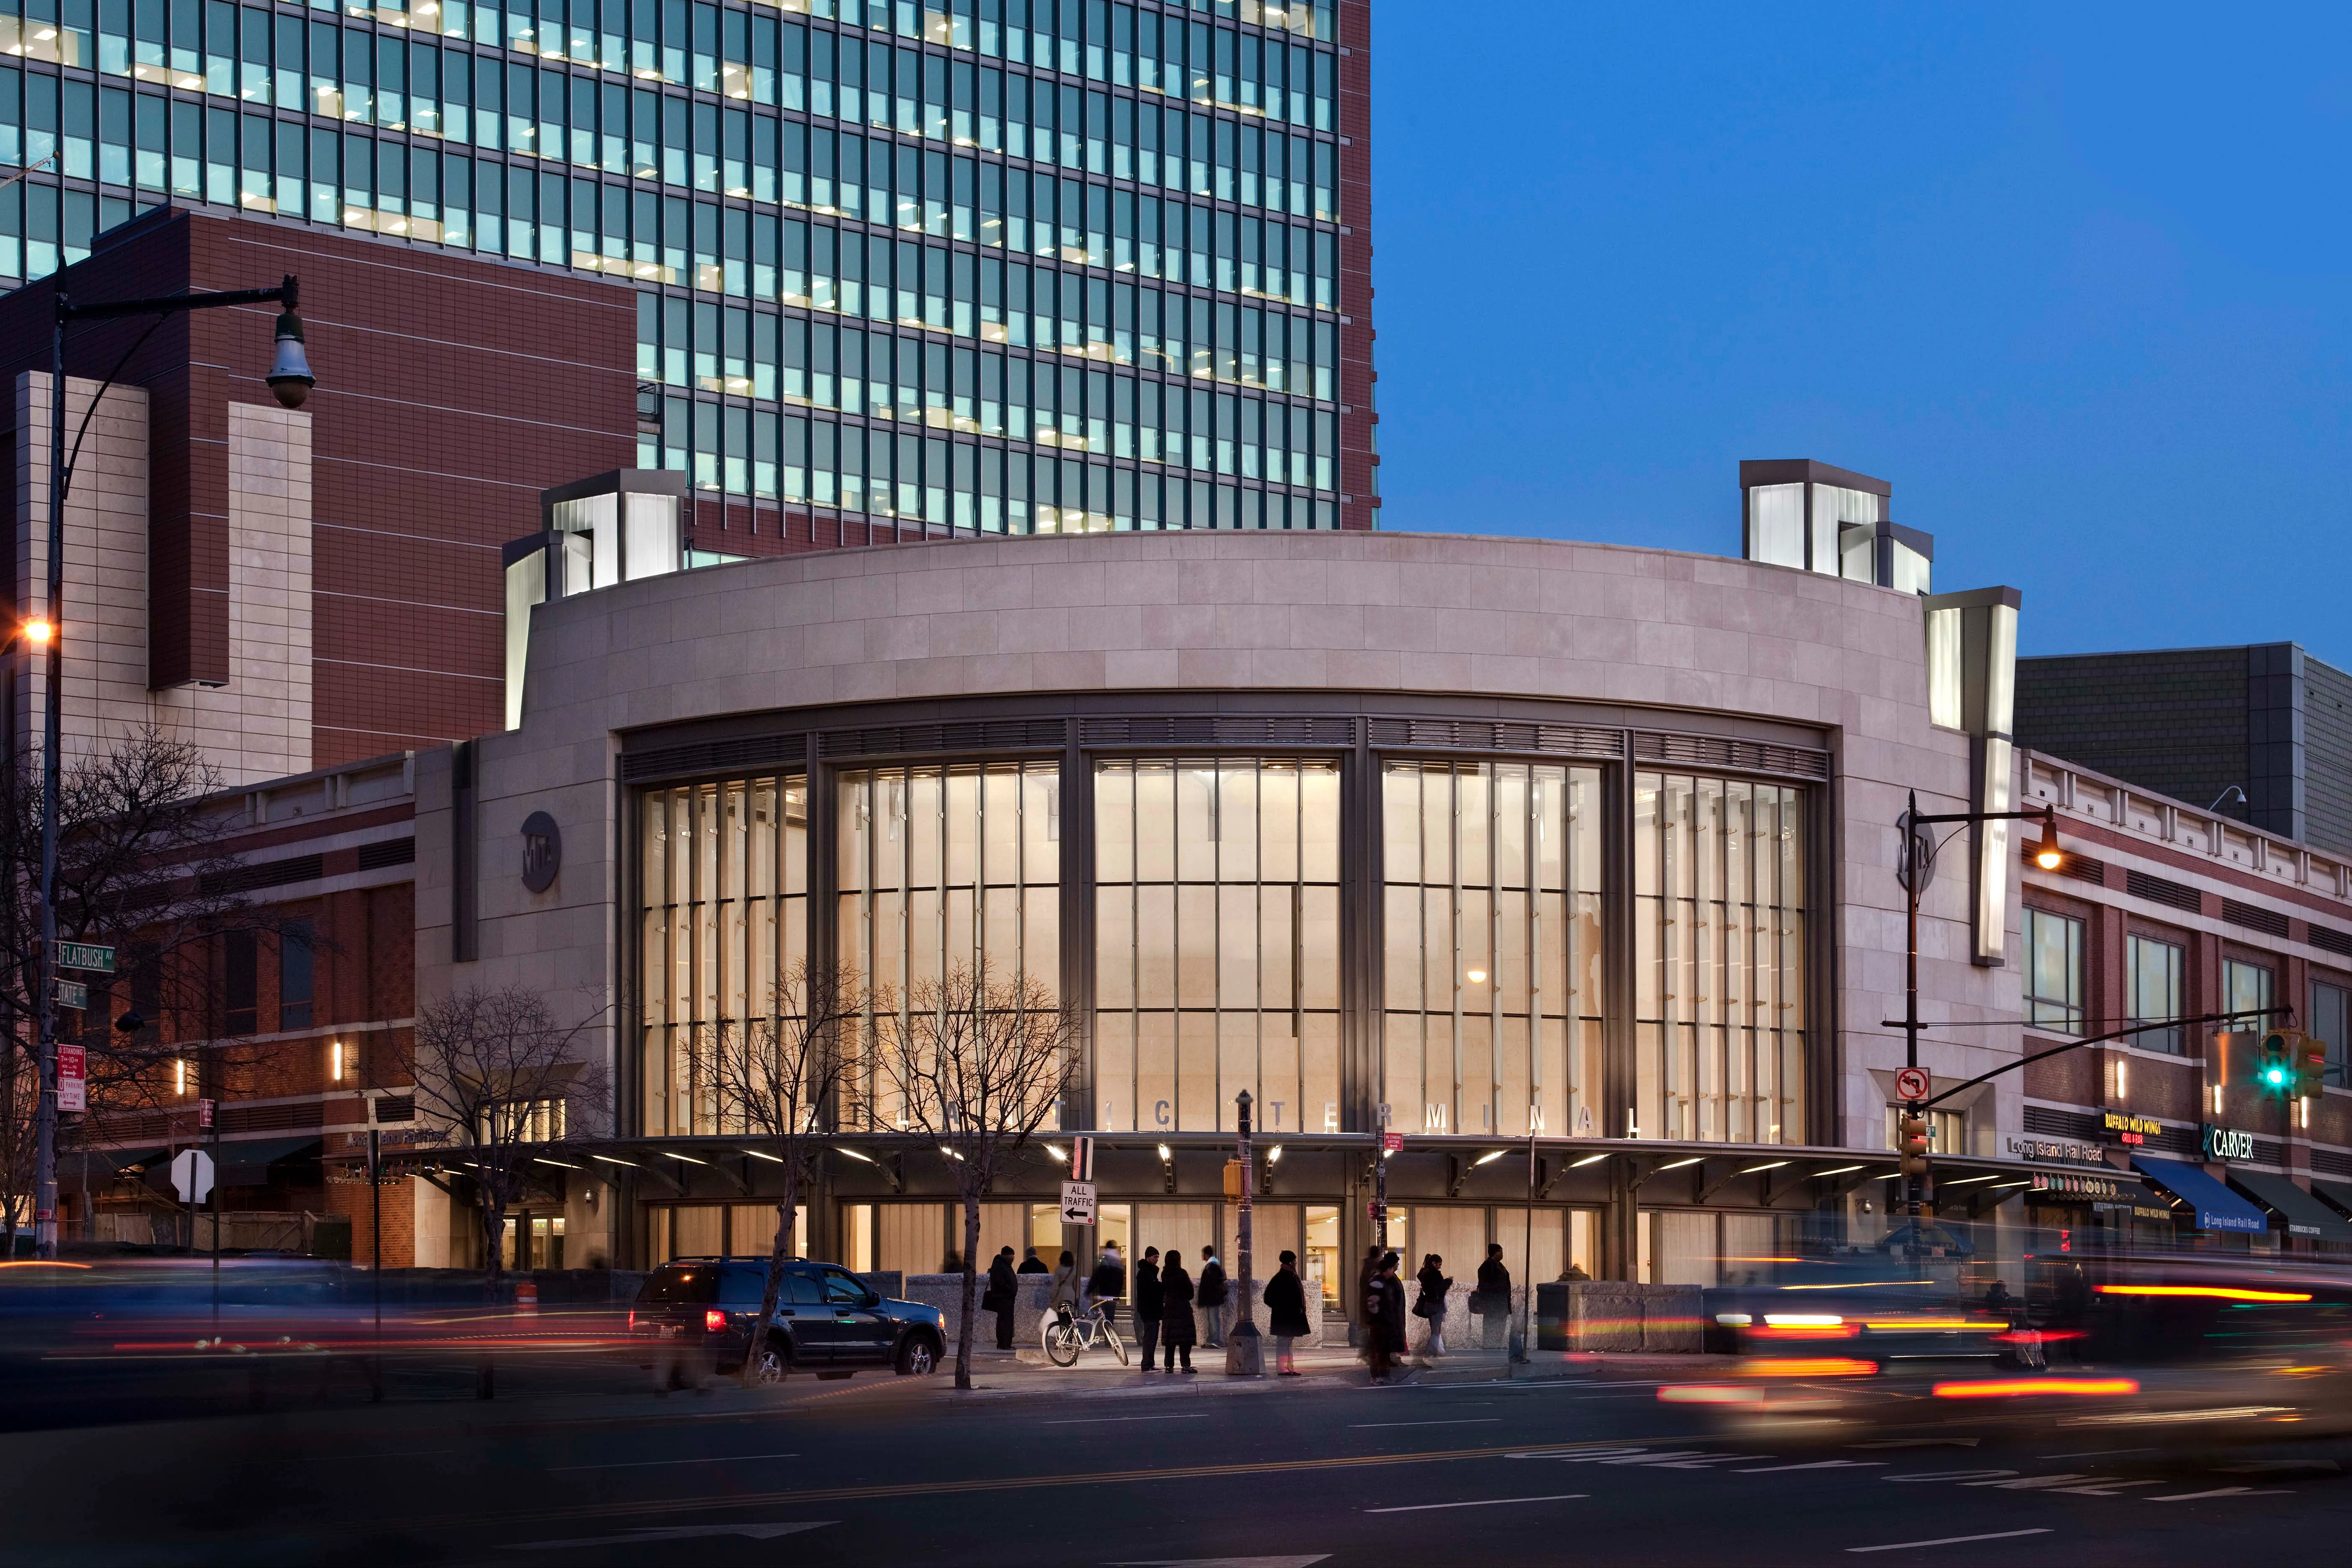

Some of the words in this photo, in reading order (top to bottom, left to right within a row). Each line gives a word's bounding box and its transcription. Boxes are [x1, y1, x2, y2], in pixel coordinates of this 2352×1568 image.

[62, 945, 103, 967] FLATBUSH
[106, 950, 113, 960] AV
[63, 1047, 83, 1055] STANDING
[1270, 1101, 1640, 1133] TERMINAL
[2105, 1113, 2128, 1131] BUFFALO
[2130, 1117, 2143, 1133] WILD
[2144, 1120, 2161, 1135] WINGS
[2122, 1132, 2131, 1143] GRILL
[2214, 1129, 2254, 1159] CARVER
[2010, 1137, 2034, 1158] Long
[2036, 1140, 2062, 1158] Island
[2066, 1143, 2080, 1159] Rail
[2082, 1145, 2102, 1161] Road
[1071, 1186, 1087, 1195] ALL
[1064, 1197, 1093, 1207] TRAFFIC
[2134, 1206, 2149, 1217] BUFFALO
[2149, 1208, 2159, 1218] WILD
[2159, 1210, 2169, 1220] WINGS
[2211, 1215, 2222, 1228] Long
[2223, 1216, 2236, 1227] Island
[2238, 1217, 2247, 1228] Rail
[2248, 1219, 2259, 1229] Road
[2289, 1225, 2308, 1233] STARBUCKS
